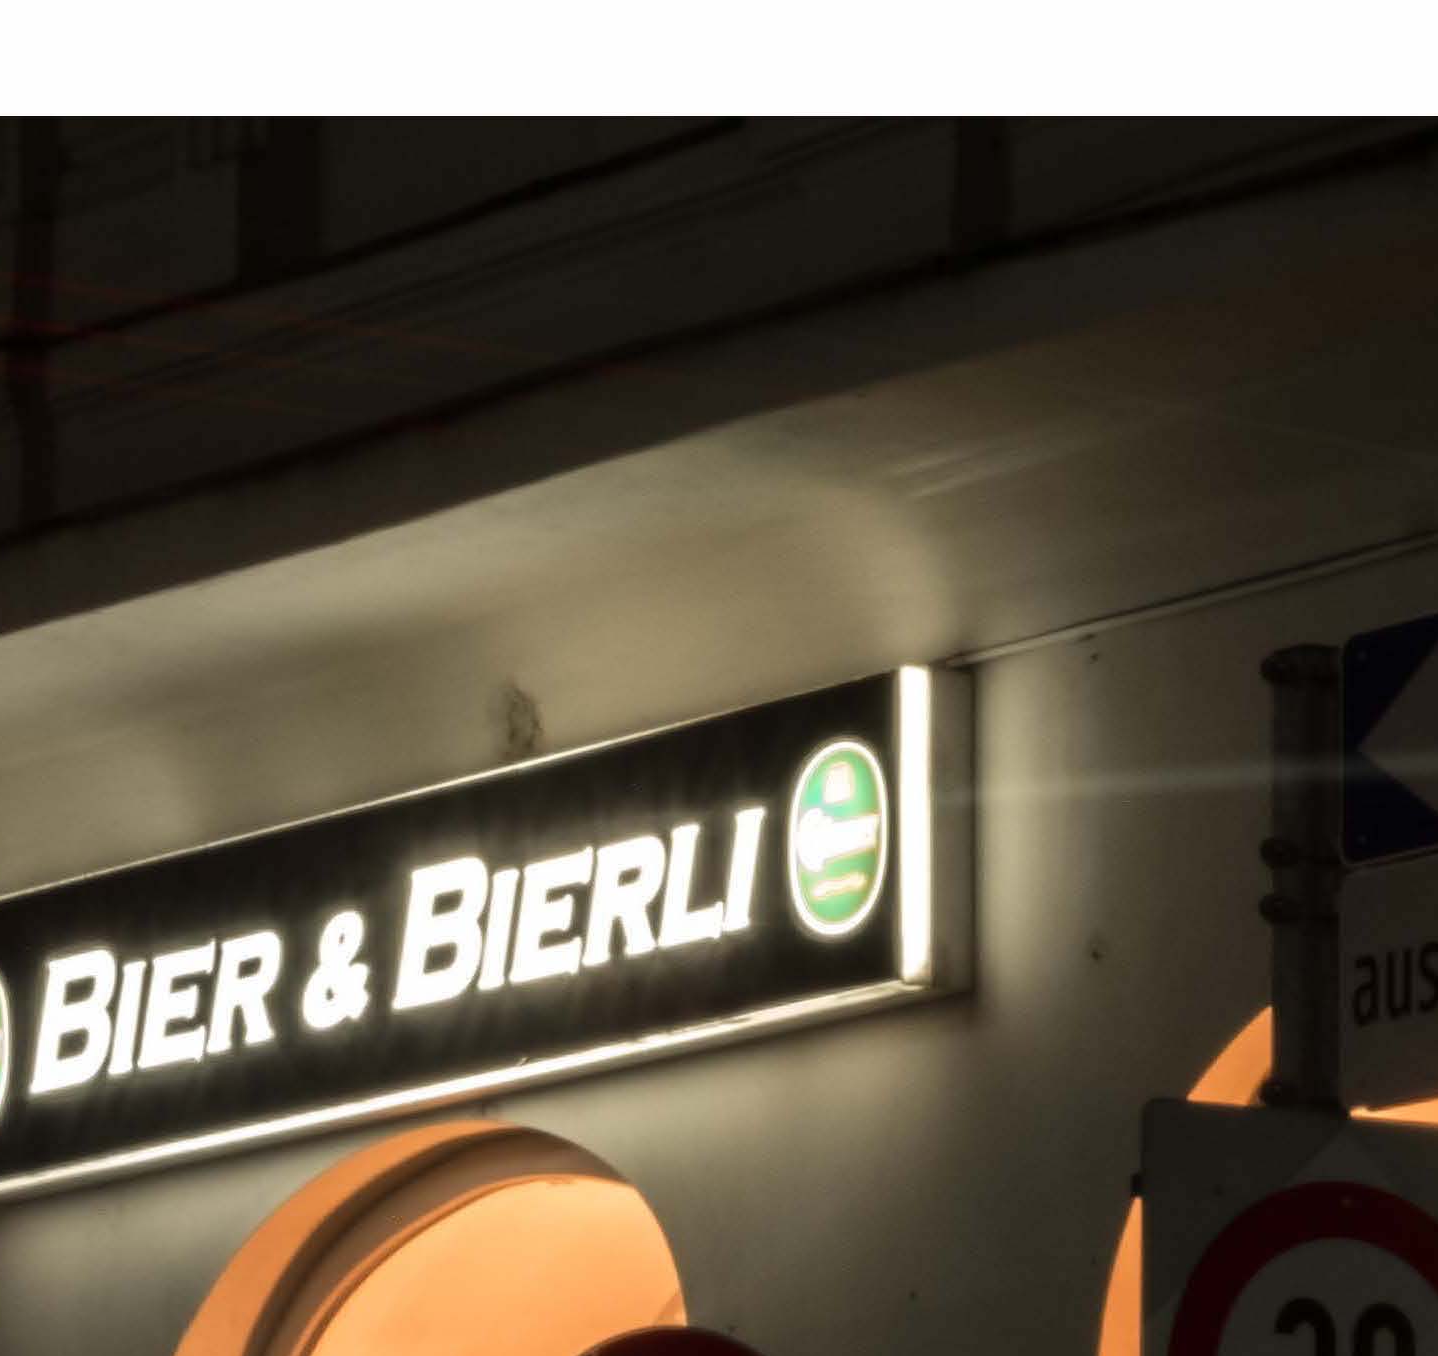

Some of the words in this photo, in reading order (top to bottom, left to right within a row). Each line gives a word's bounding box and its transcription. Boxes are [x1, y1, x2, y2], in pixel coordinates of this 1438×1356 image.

[29, 931, 282, 1095] BIER
[302, 910, 369, 1030] &
[391, 806, 766, 1010] BIERLI
